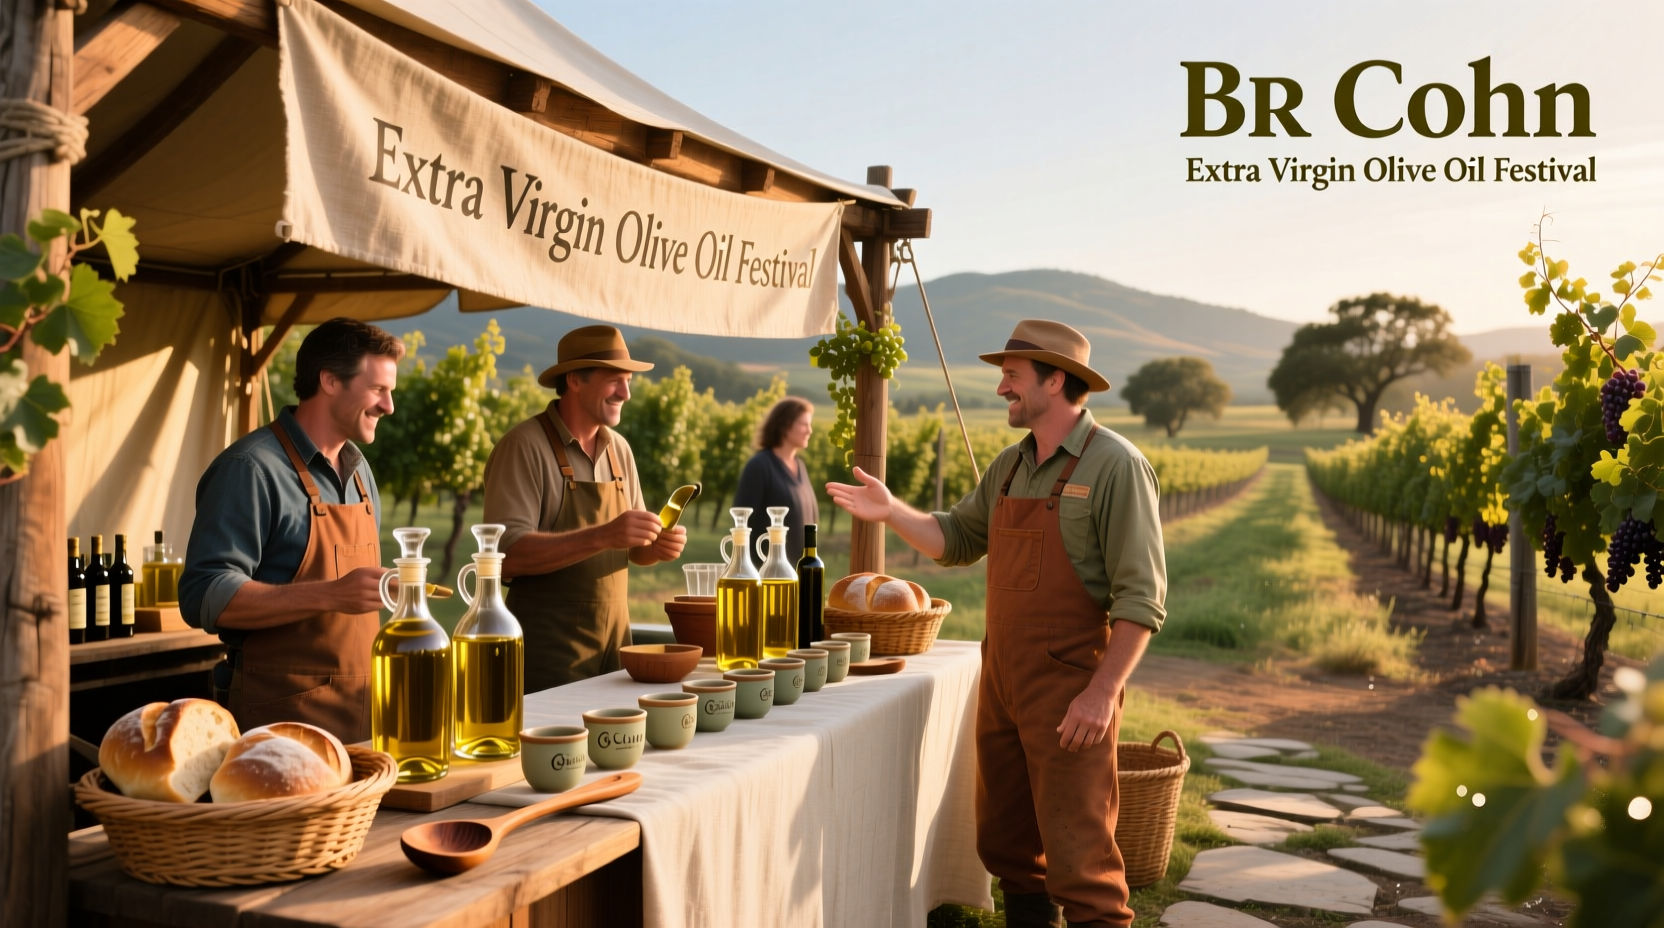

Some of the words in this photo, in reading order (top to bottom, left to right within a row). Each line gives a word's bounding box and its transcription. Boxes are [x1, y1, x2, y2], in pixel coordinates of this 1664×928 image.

[369, 117, 483, 219] Extra
[500, 165, 604, 263] Virgin
[616, 210, 688, 274] Olive
[695, 230, 734, 281] Oil
[735, 240, 817, 289] Festival
